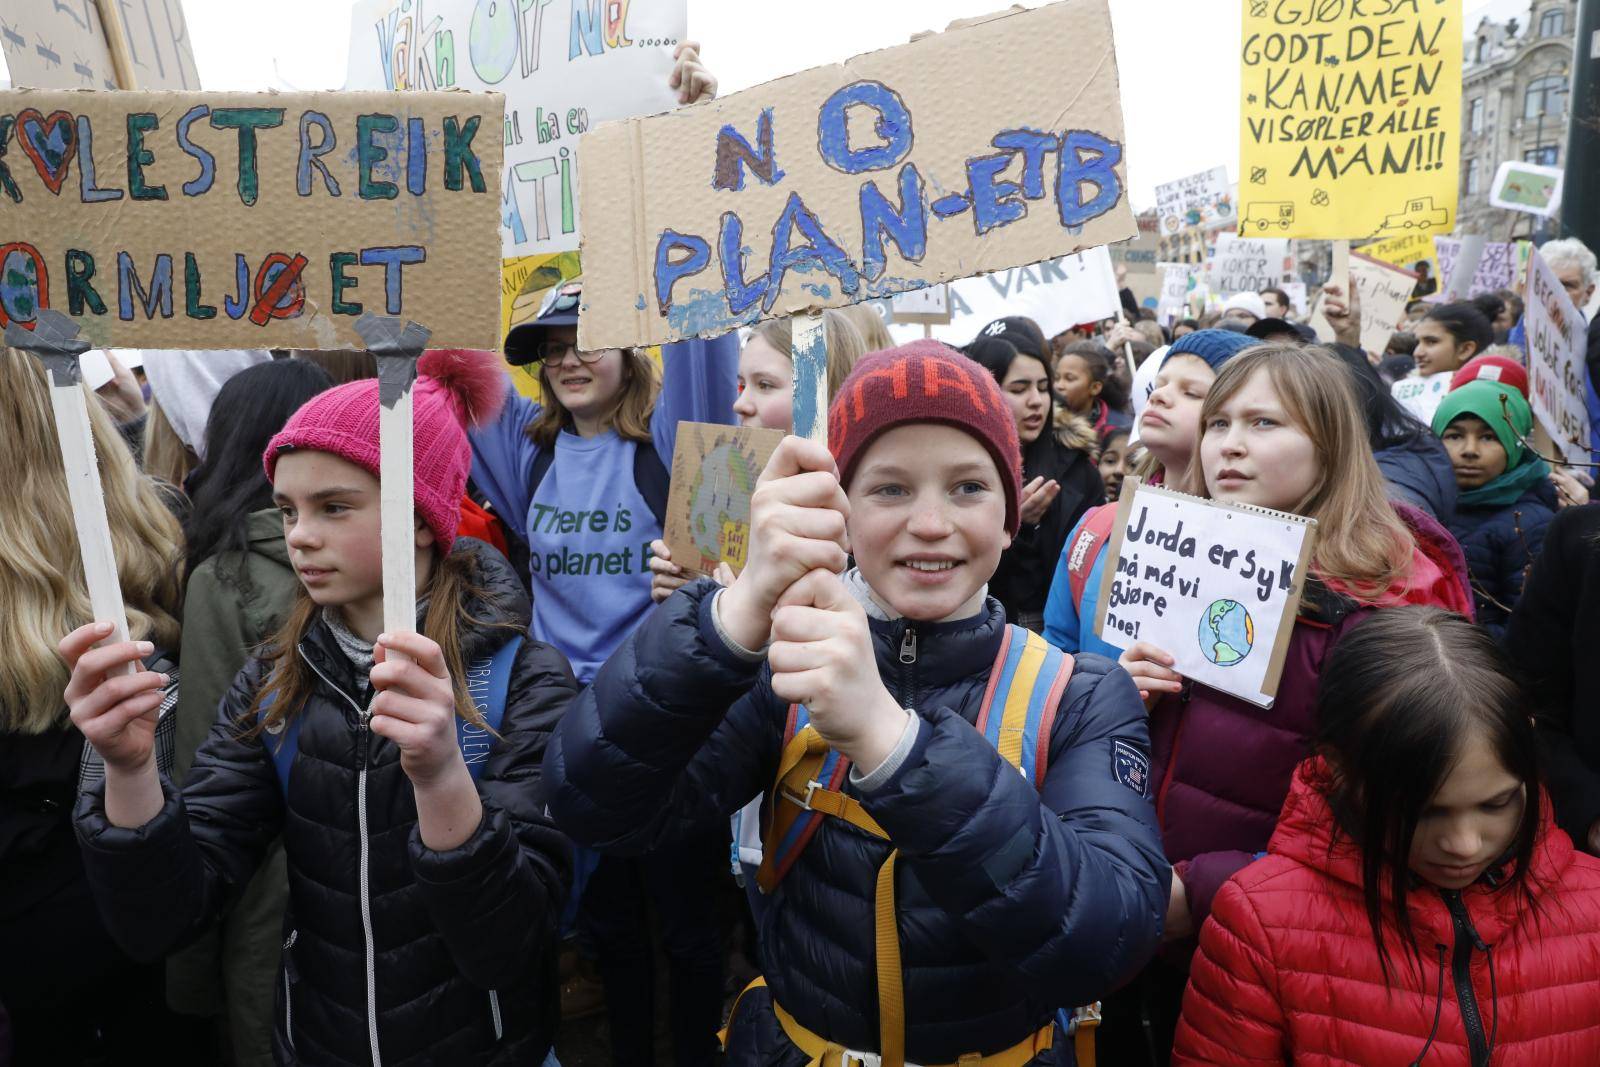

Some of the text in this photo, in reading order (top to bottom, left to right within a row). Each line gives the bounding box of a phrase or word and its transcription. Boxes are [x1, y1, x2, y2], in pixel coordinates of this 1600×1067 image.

[1346, 17, 1446, 62] DEN
[1346, 60, 1443, 105] MEN
[713, 79, 914, 192] NO
[1289, 131, 1446, 180] MAN!!!
[1228, 240, 1265, 256] ERNA
[532, 502, 631, 534] There is
[1126, 507, 1196, 558] Jorda
[1208, 543, 1239, 570] er
[546, 546, 633, 580] planet
[1144, 564, 1177, 590] må
[1178, 576, 1200, 599] vi
[1109, 578, 1168, 618] gjøre
[1106, 611, 1141, 640] noe!
